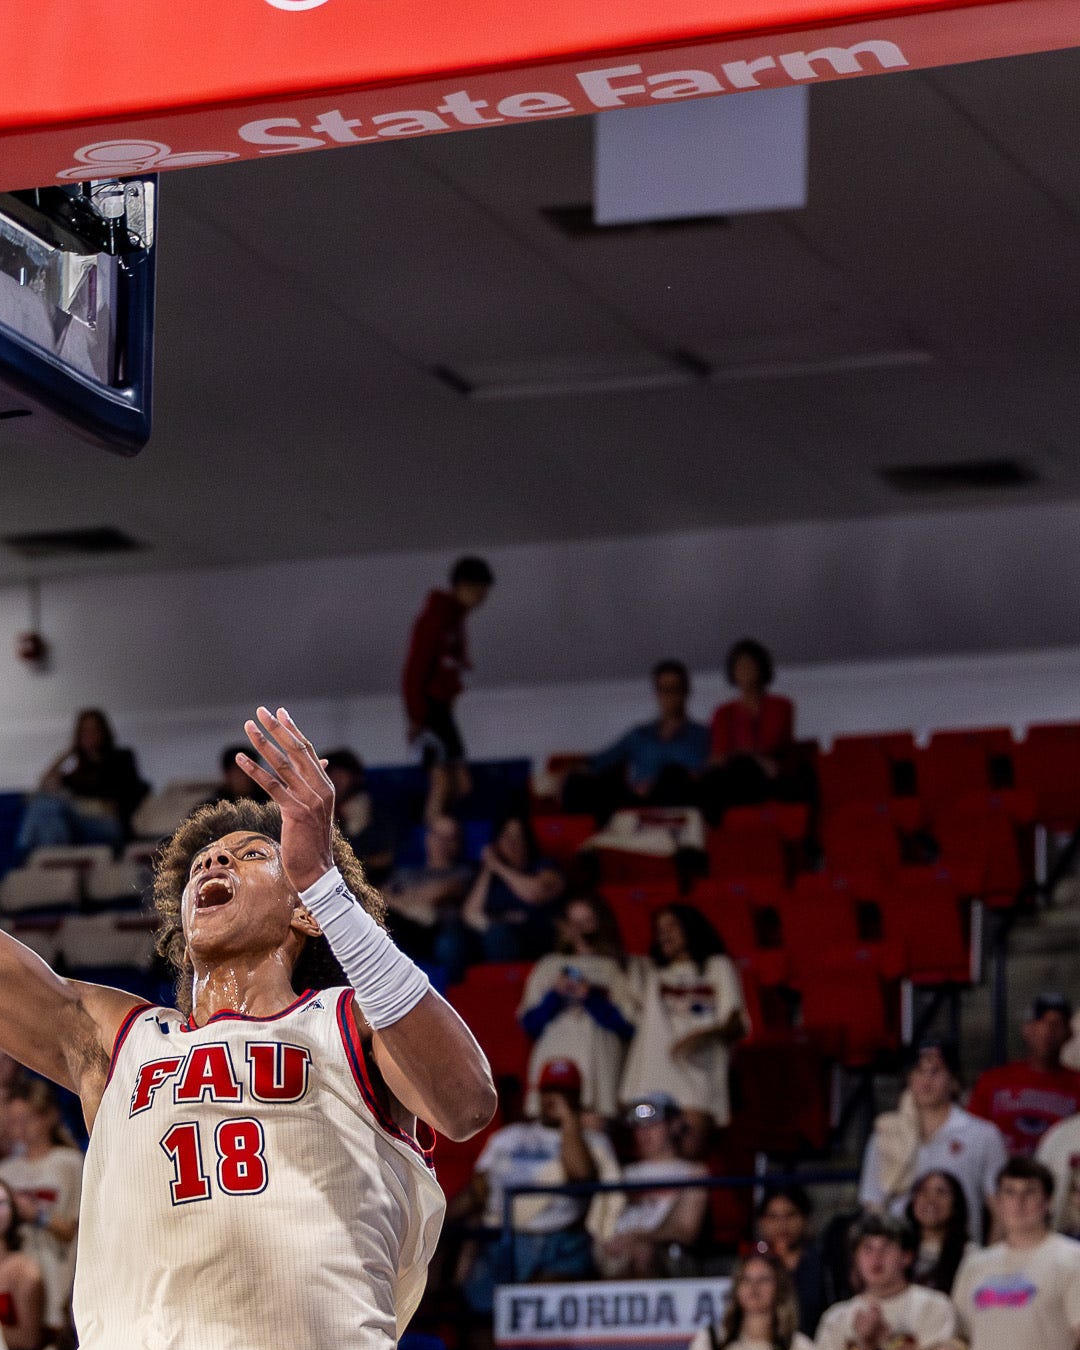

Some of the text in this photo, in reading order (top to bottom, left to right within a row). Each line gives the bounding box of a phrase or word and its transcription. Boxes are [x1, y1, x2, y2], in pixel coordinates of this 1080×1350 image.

[237, 38, 910, 155] State Farm
[128, 1040, 313, 1120] FAU
[158, 1116, 269, 1207] 18
[510, 1291, 676, 1332] FLORIDA
